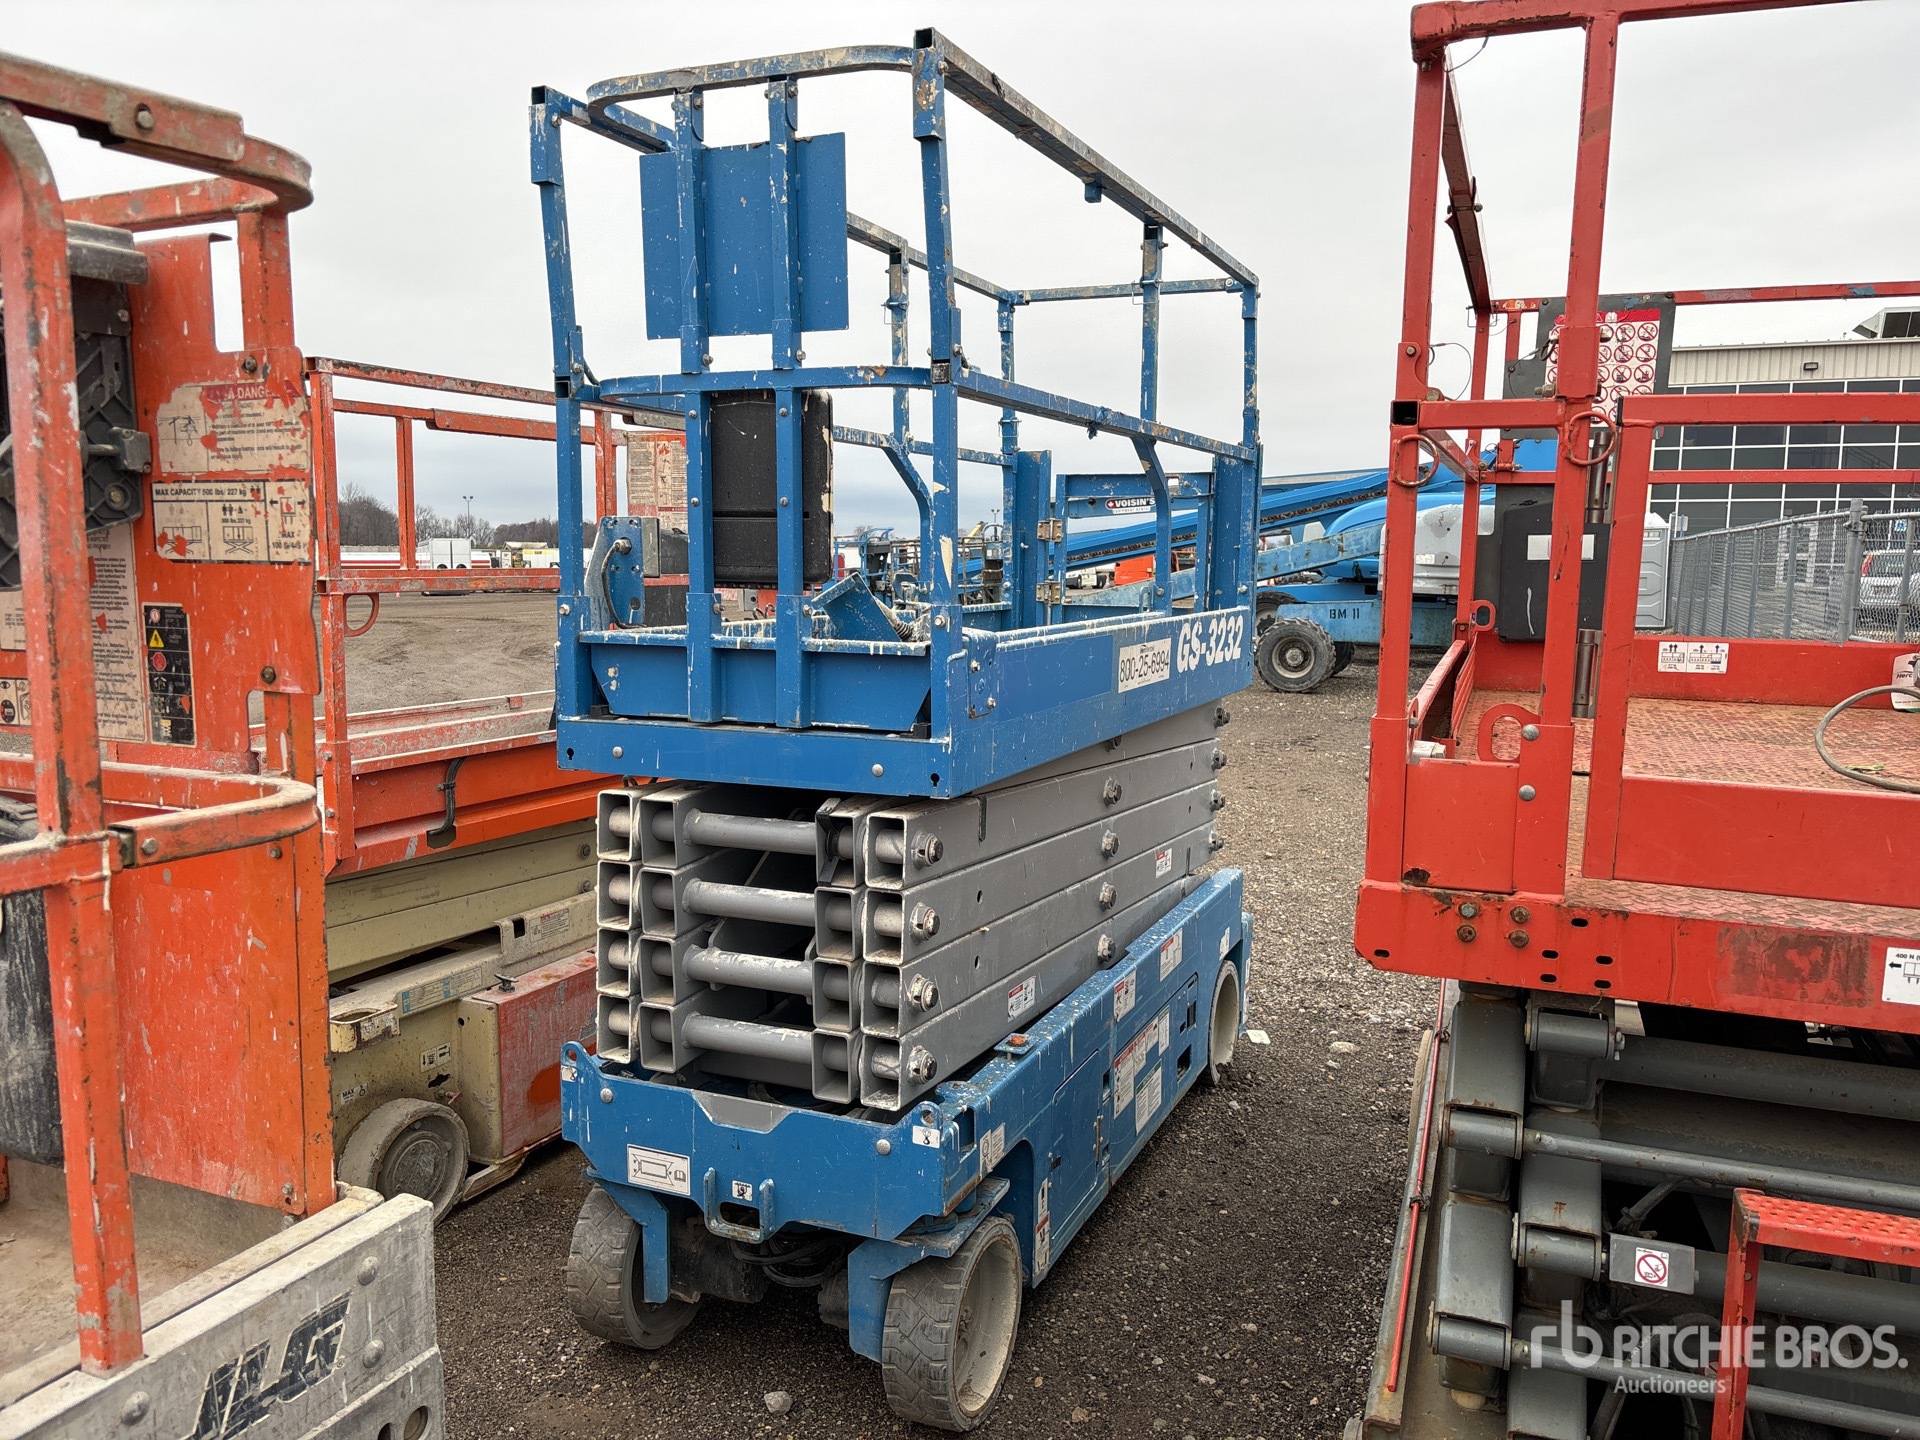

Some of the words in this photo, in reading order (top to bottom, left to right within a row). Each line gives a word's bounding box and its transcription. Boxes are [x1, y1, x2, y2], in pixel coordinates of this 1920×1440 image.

[170, 488, 201, 496] CAPACITY
[202, 488, 213, 496] 500
[239, 489, 247, 497] kg
[1114, 497, 1156, 508] VOISIN'S
[1329, 608, 1347, 619] BM
[1176, 614, 1244, 674] GS-3232
[1119, 650, 1170, 683] 800-25-6994
[342, 1088, 355, 1098] MAX
